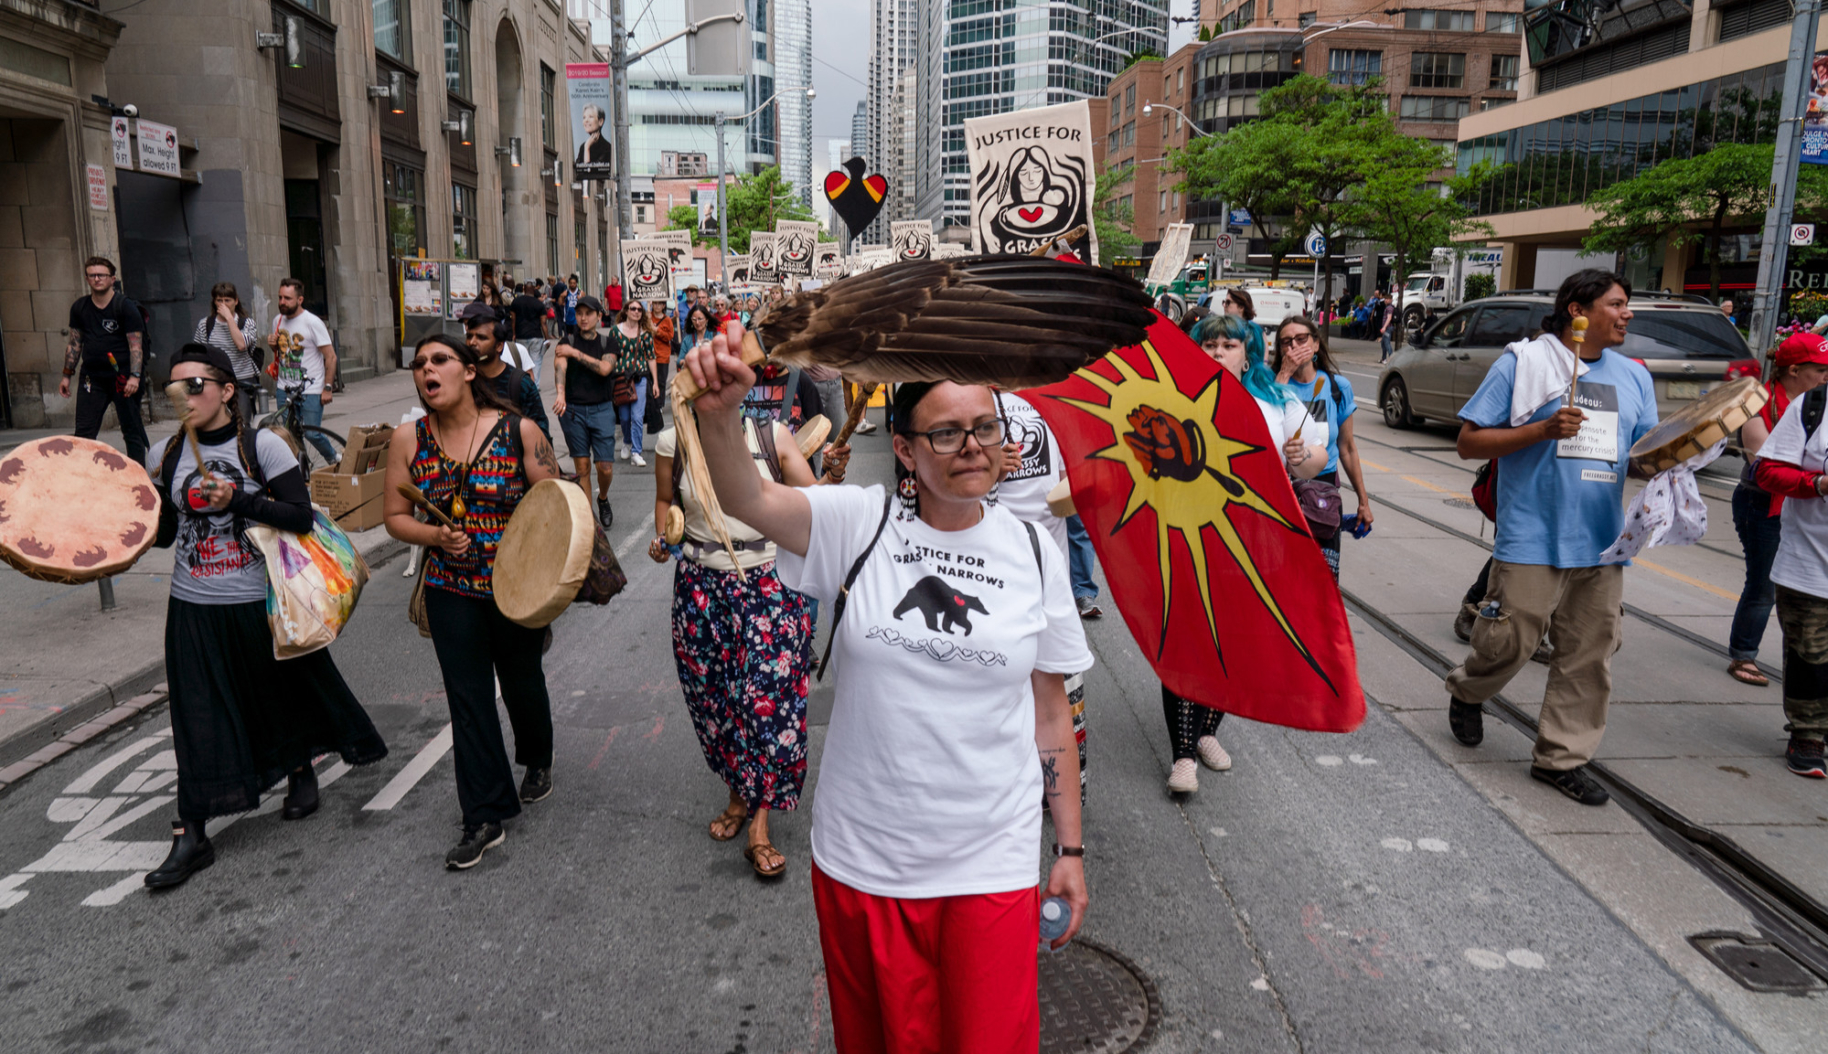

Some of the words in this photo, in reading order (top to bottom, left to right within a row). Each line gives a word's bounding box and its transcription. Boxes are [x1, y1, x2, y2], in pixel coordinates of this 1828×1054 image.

[975, 126, 1040, 150] JUSTICE
[1047, 126, 1081, 142] FOR
[112, 138, 126, 151] ight
[142, 143, 156, 156] Max.
[157, 147, 175, 160] Height
[1802, 148, 1821, 156] HEART
[115, 152, 120, 163] 9
[121, 153, 128, 164] FT
[143, 158, 165, 171] allowed
[166, 161, 170, 171] 9
[803, 226, 816, 235] FOR
[626, 246, 651, 254] JUSTICE
[779, 266, 809, 274] NARROWS
[783, 261, 807, 269] GRASSY
[632, 291, 666, 299] NARROWS
[637, 285, 662, 293] GRASSY
[1564, 393, 1603, 408] Tudeau:
[1581, 424, 1607, 436] pensate
[1587, 435, 1599, 444] the
[1561, 443, 1594, 454] mercury
[1594, 446, 1616, 455] crisis?
[1020, 457, 1040, 469] ASSY
[1006, 464, 1047, 479] ARROWS
[197, 535, 224, 562] WE
[225, 540, 243, 555] THE
[190, 552, 254, 579] RESISTANCE
[956, 554, 985, 568] FOR
[937, 564, 1005, 589] NARROWS
